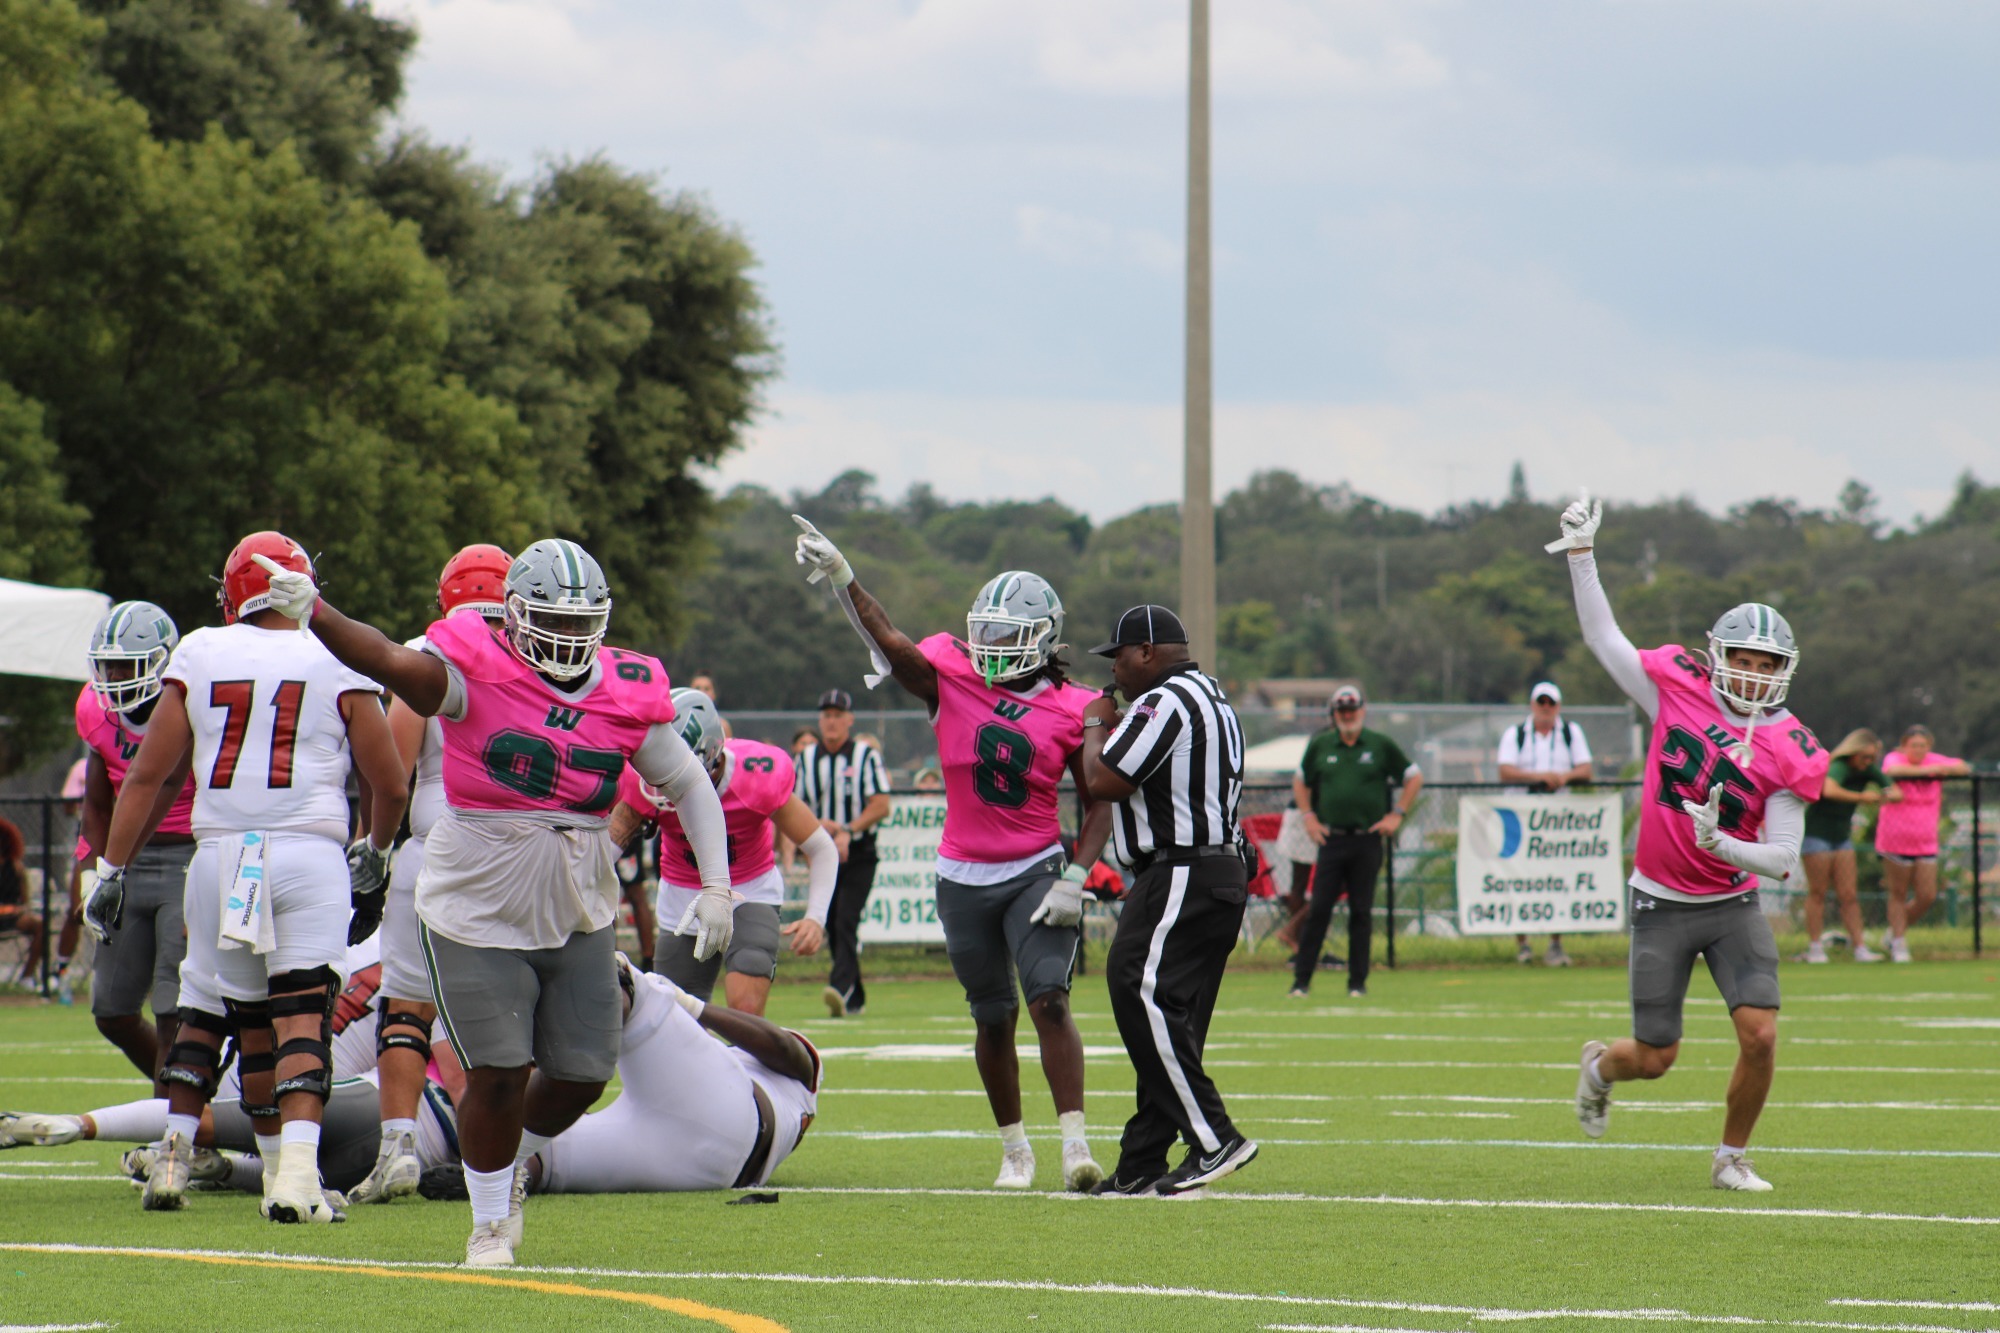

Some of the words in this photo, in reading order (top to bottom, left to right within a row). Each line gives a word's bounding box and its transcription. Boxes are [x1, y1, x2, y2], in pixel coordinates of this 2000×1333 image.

[543, 705, 587, 732] W
[992, 698, 1033, 721] W
[208, 679, 306, 789] 71
[681, 710, 704, 749] W
[1704, 722, 1740, 749] W
[482, 727, 627, 812] 97
[744, 756, 774, 773] 3
[973, 720, 1036, 809] 8
[1528, 808, 1603, 832] United
[1527, 836, 1608, 858] Rentals
[1482, 874, 1569, 893] Sarasota,
[1575, 873, 1596, 891] FL
[241, 882, 257, 927] POWERADE
[899, 899, 937, 924] 812
[1468, 903, 1512, 926] (941)
[1518, 902, 1553, 921] 650
[1571, 901, 1617, 919] 6102
